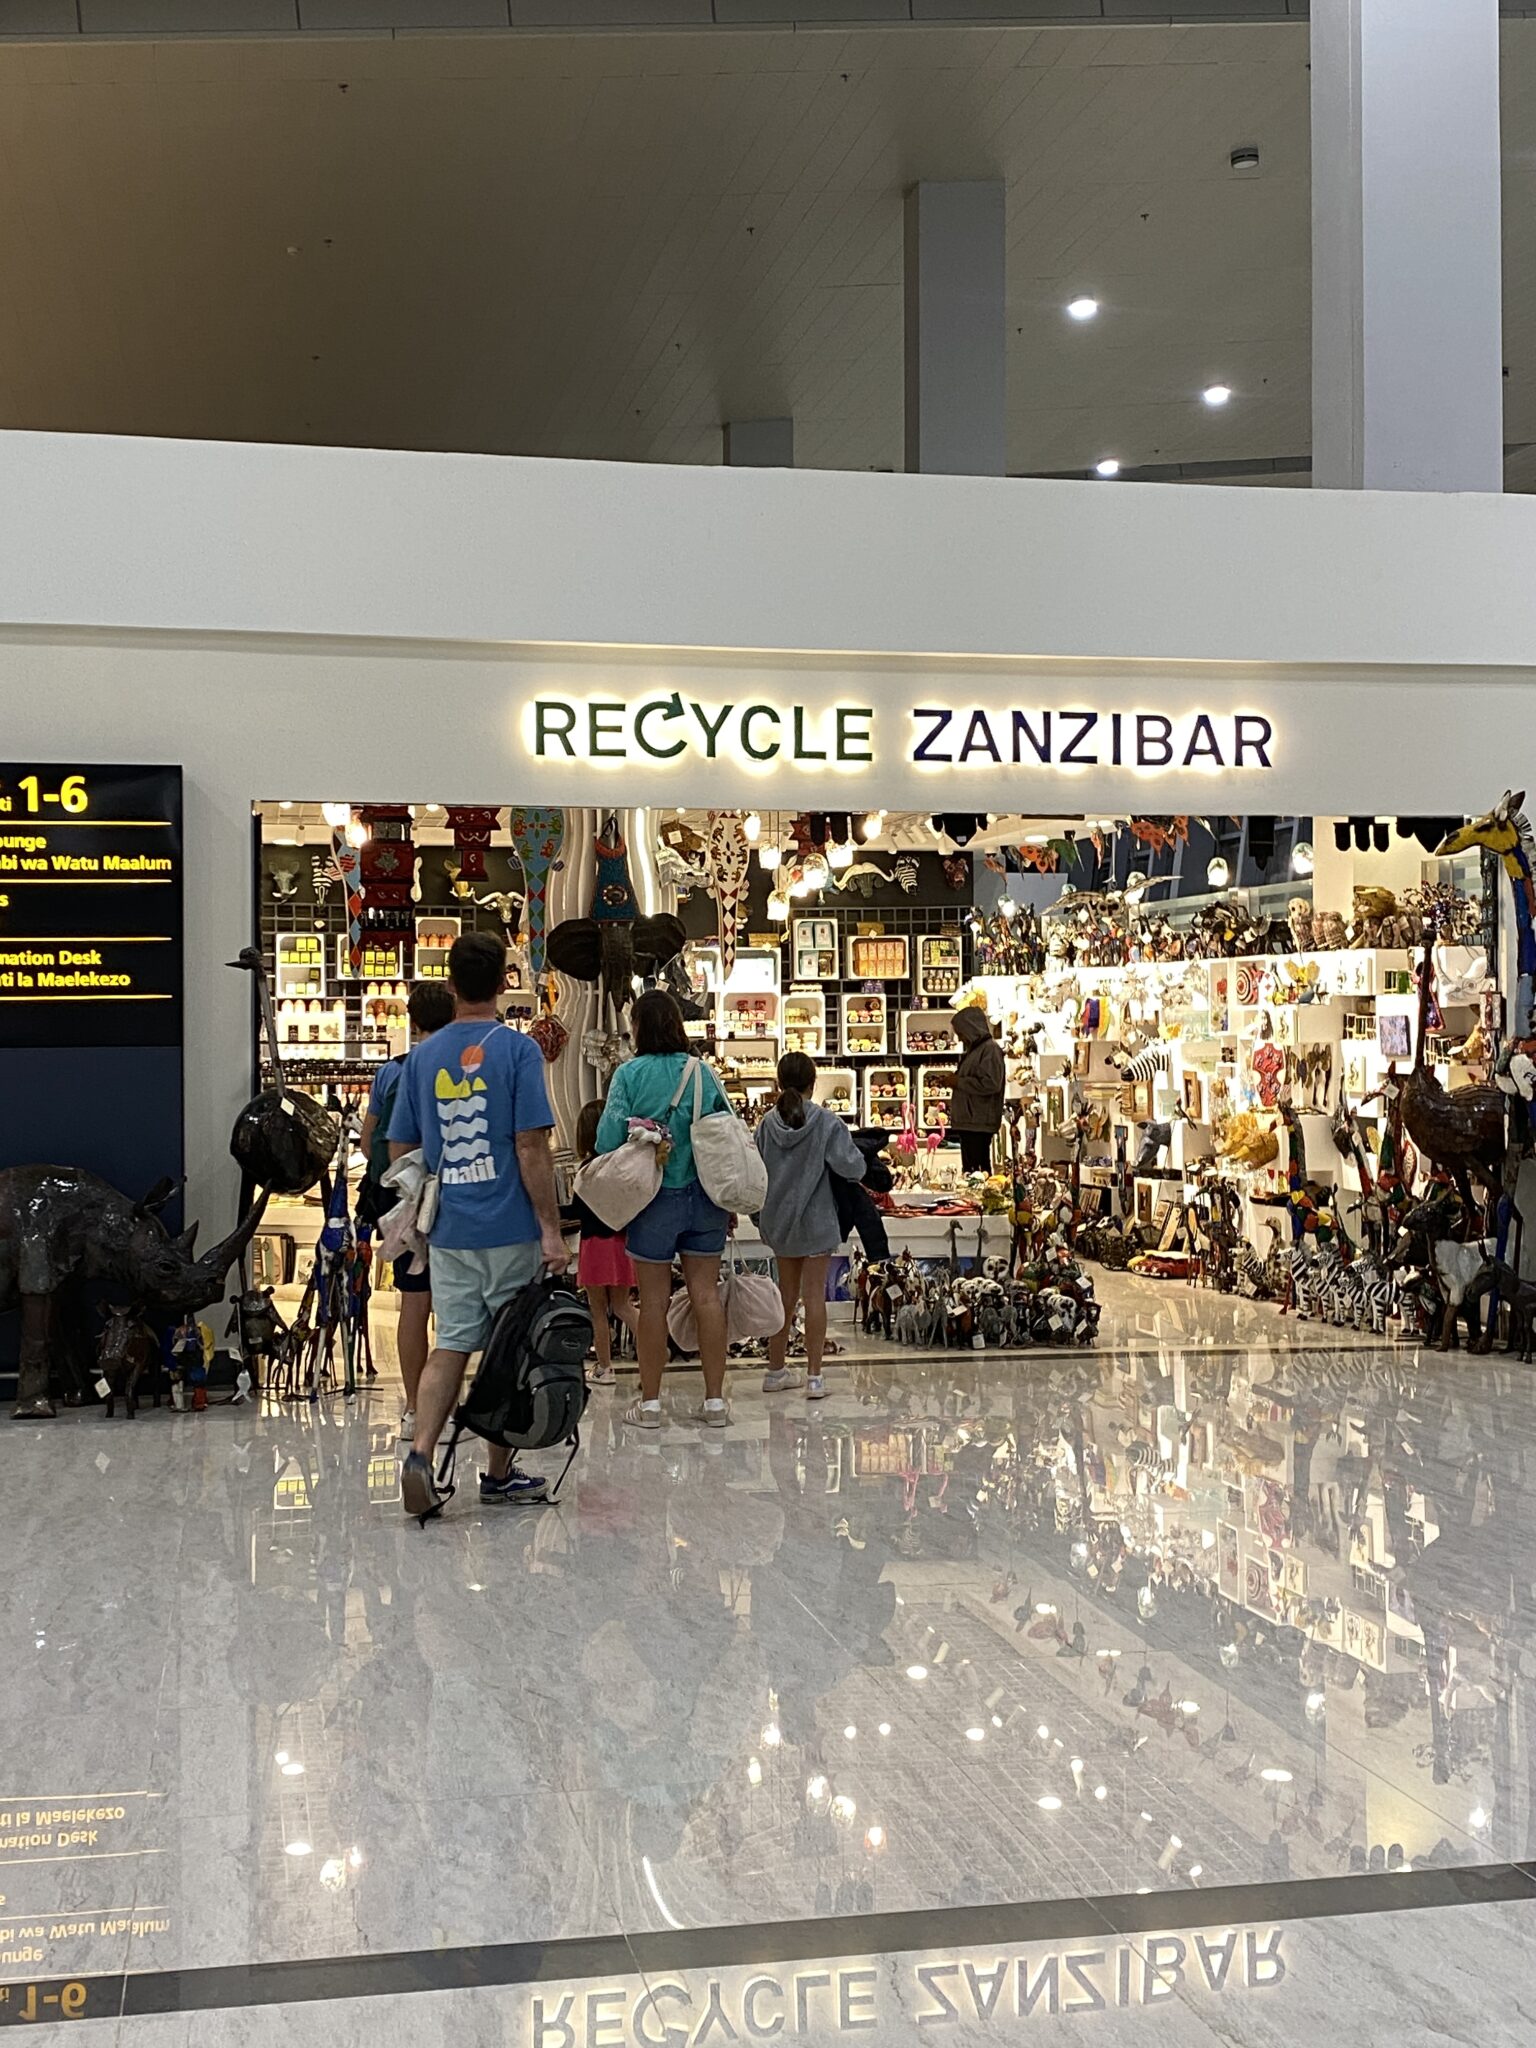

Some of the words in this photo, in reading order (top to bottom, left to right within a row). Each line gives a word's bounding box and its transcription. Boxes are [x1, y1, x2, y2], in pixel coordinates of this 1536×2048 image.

[534, 692, 873, 762] RECYCLE
[912, 708, 1272, 768] ZANZIBAR
[18, 775, 88, 813] 1-6
[0, 854, 18, 870] bi
[20, 858, 48, 870] wa
[51, 855, 98, 870] Watu
[103, 855, 171, 871] Maalum
[59, 949, 101, 965] Desk
[17, 972, 34, 987] la
[37, 971, 131, 987] Maelekezo
